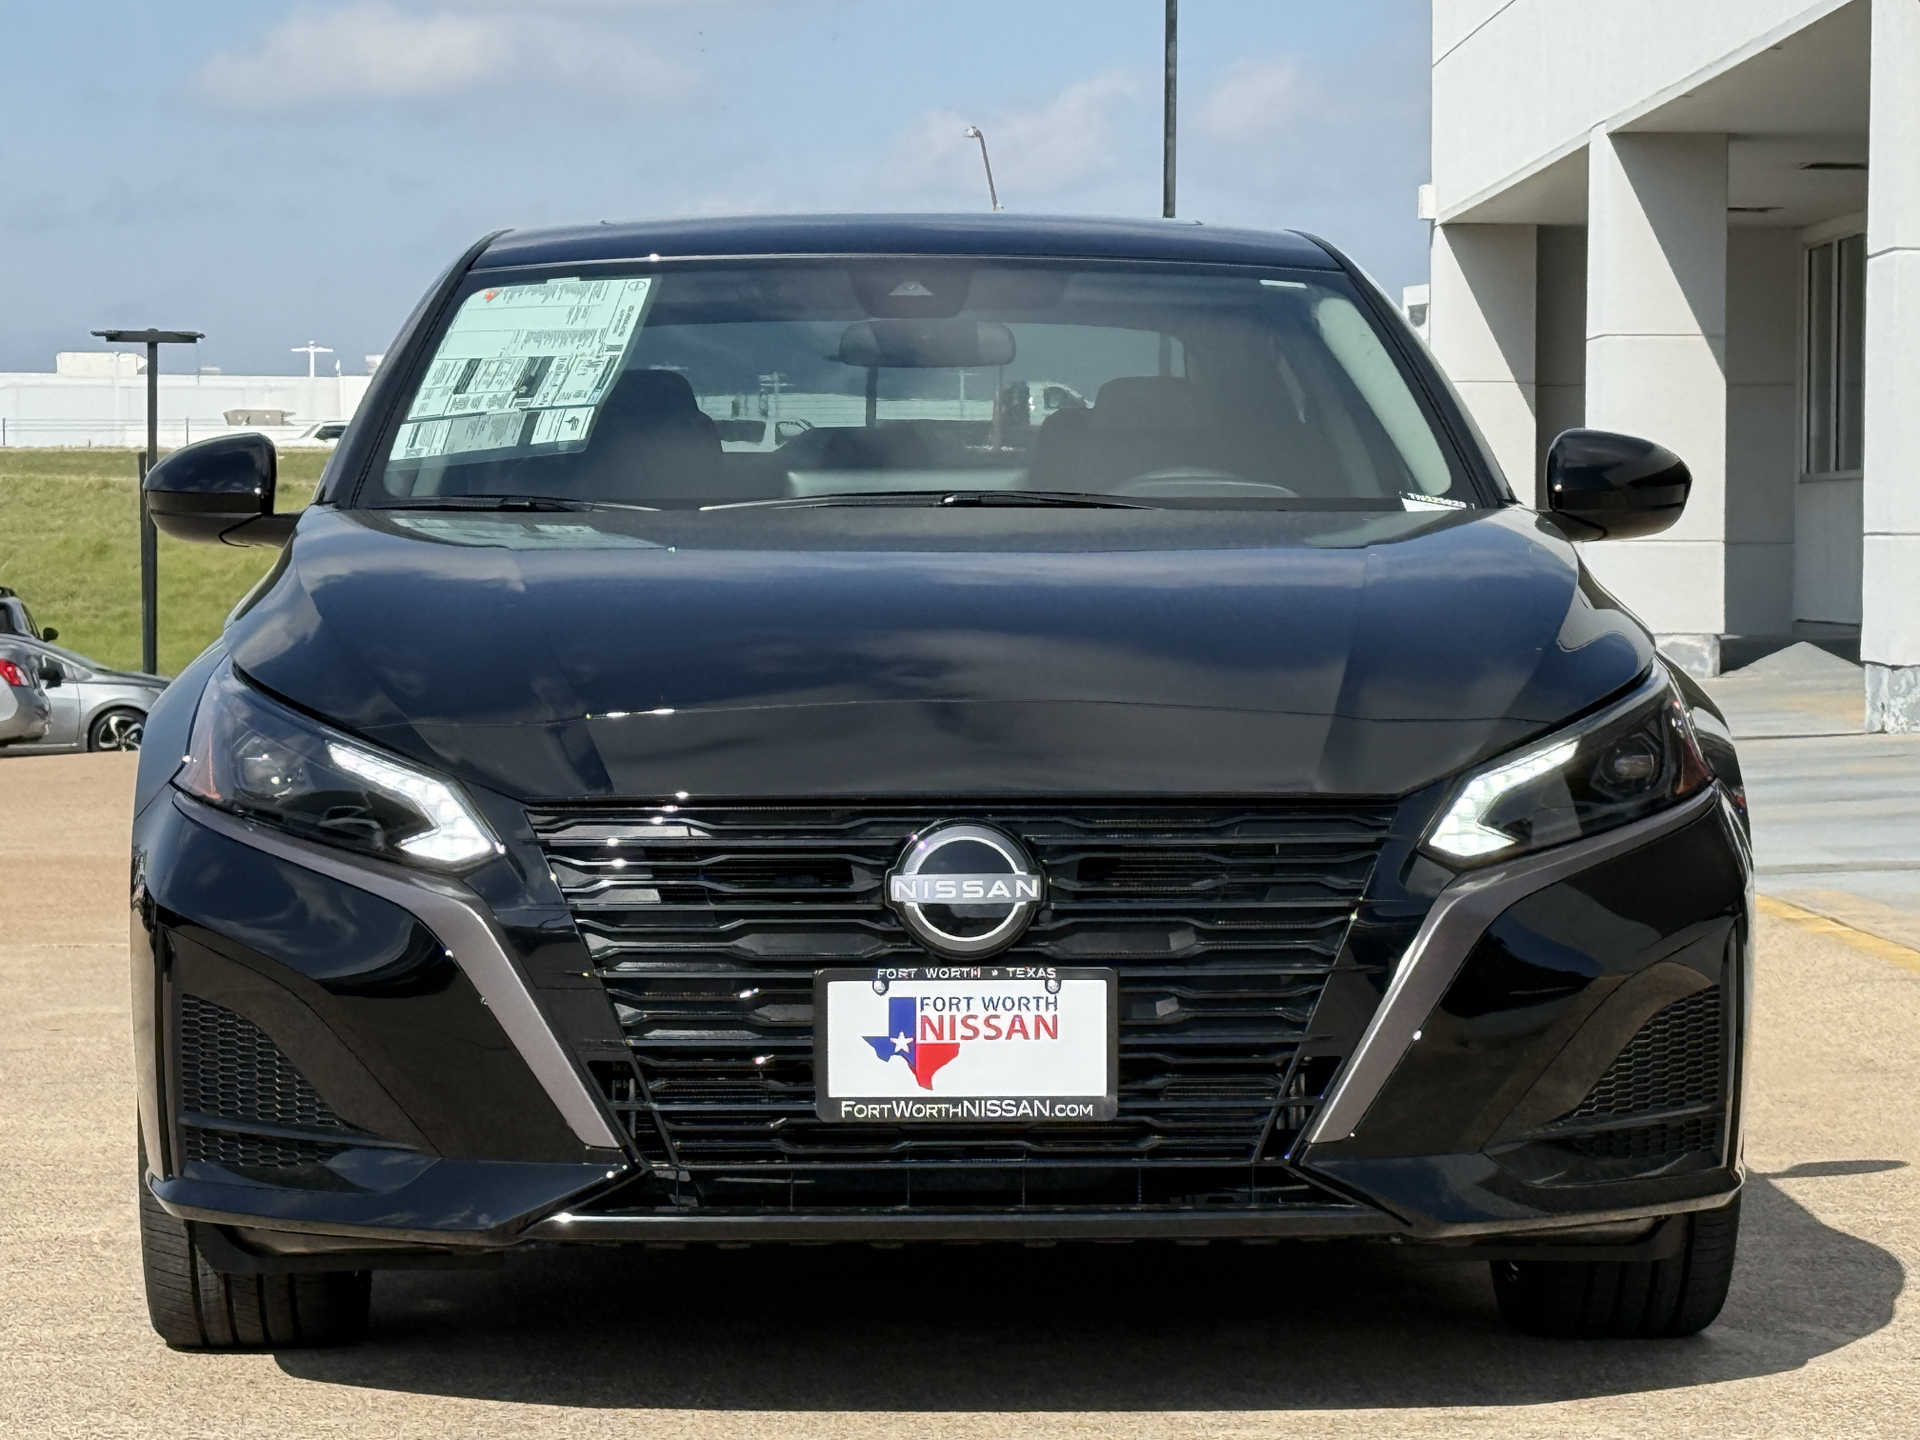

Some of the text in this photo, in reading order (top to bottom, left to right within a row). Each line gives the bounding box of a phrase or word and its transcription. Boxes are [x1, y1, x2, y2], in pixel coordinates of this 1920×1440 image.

[893, 880, 1038, 898] NISSAN
[877, 967, 1057, 978] FORT WORTH TEXAS
[920, 996, 1058, 1012] FORT WORTH
[920, 1014, 1058, 1040] NISSAN
